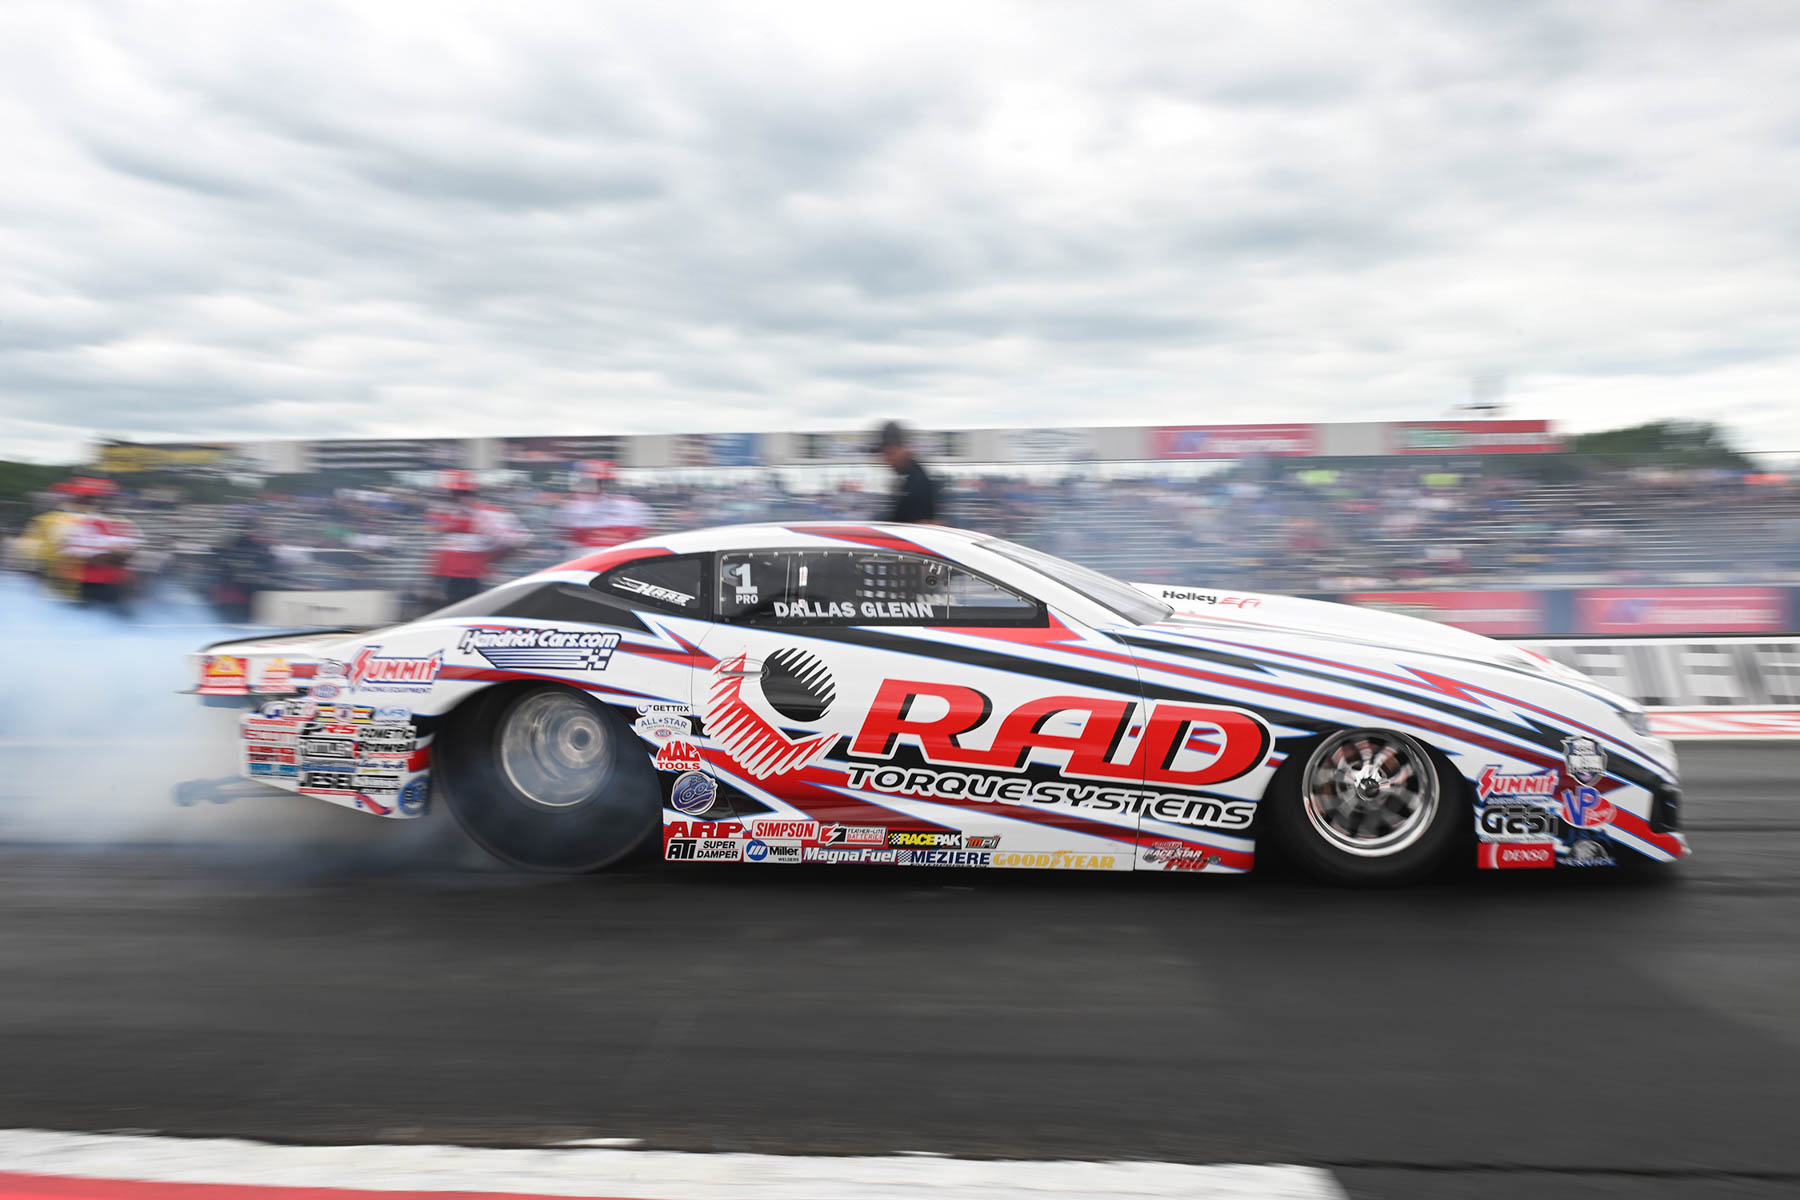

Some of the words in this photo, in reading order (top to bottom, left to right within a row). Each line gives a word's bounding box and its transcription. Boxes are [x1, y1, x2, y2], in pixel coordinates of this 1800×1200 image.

[735, 563, 758, 594] 1
[735, 595, 758, 604] PRO
[1162, 590, 1217, 605] Holley
[774, 602, 856, 618] DALLAS
[861, 602, 934, 618] GLENN
[653, 704, 690, 713] GETTRX
[851, 677, 1271, 785] RAD
[657, 741, 701, 762] MAC
[1563, 787, 1599, 827] VP
[664, 821, 743, 838] ARP
[755, 823, 815, 838] SIMPSON
[703, 841, 736, 849] SUPER
[899, 833, 961, 846] RACEPAK
[667, 839, 697, 859] ATI
[697, 850, 739, 859] DAMPER
[769, 847, 799, 856] Miller
[803, 847, 897, 864] MagnaFuel
[1502, 848, 1550, 861] DENSO
[911, 851, 991, 866] MEZIERE
